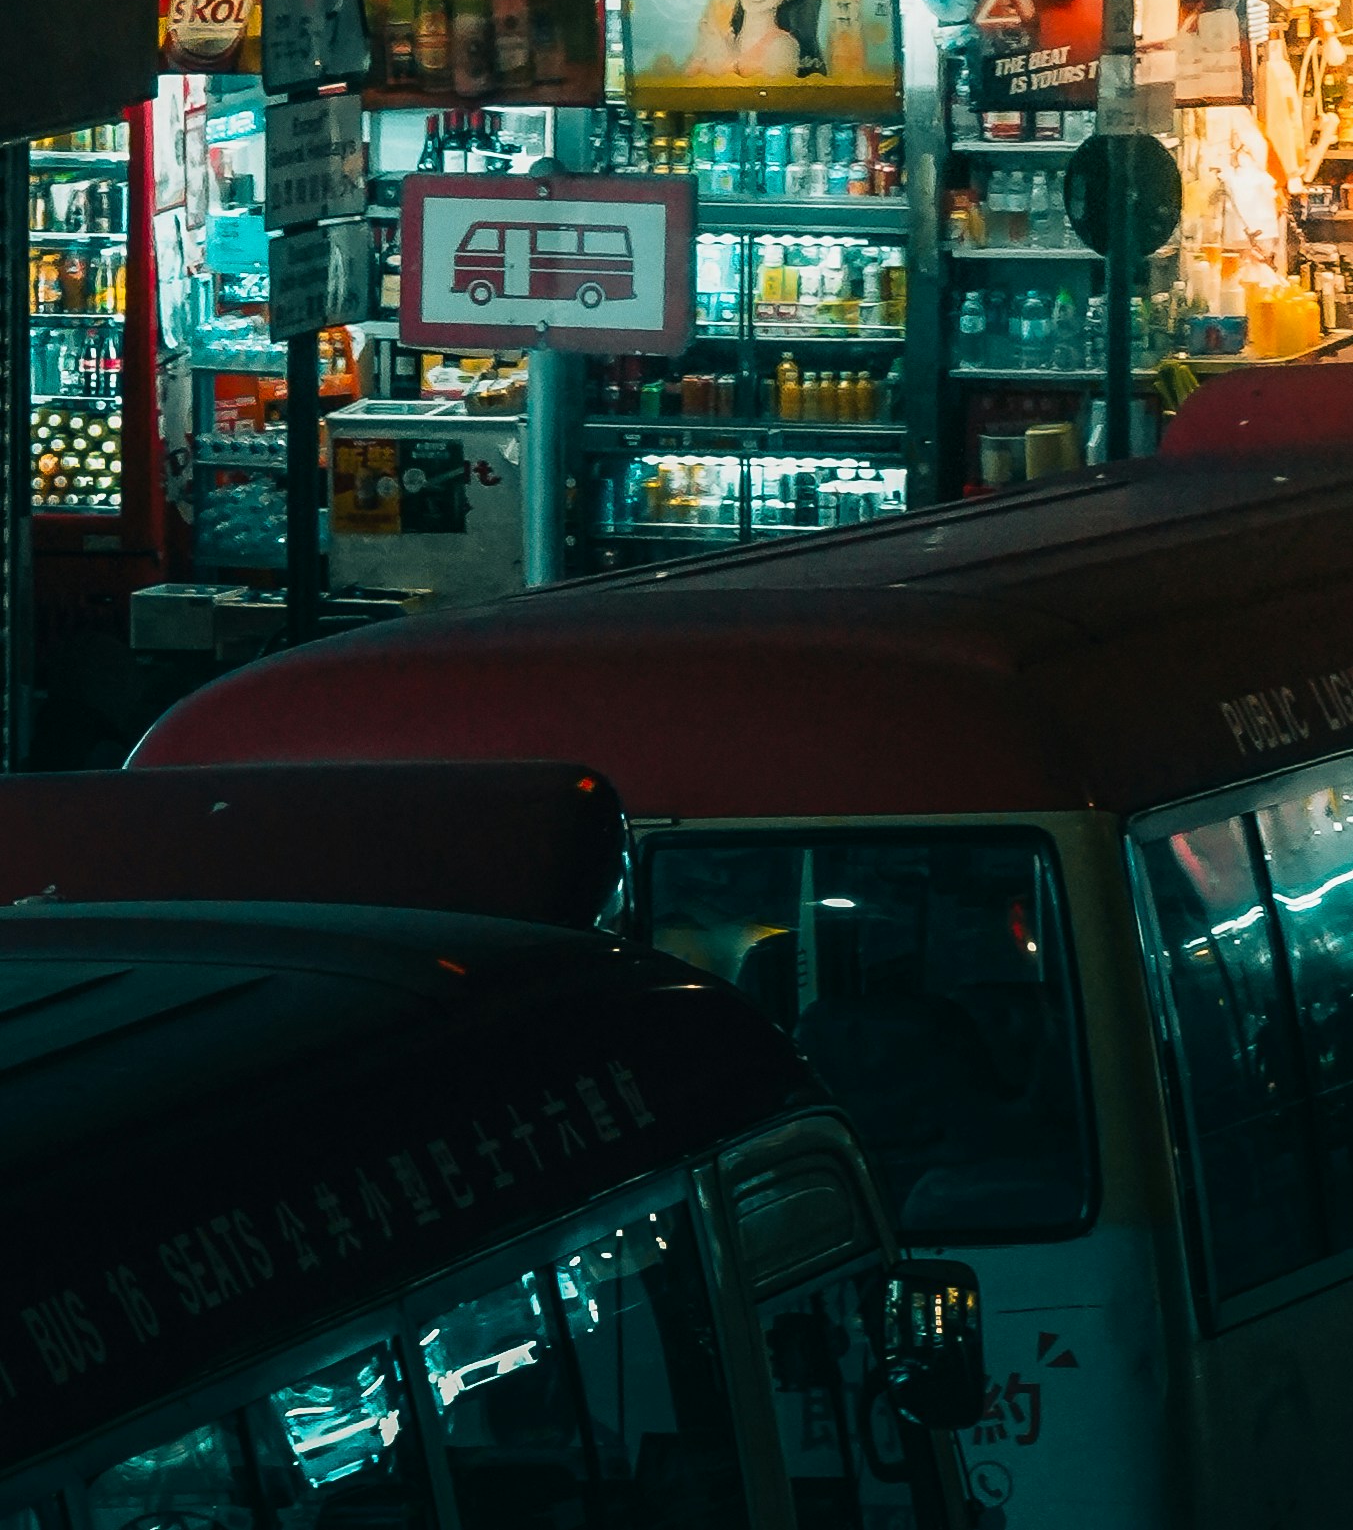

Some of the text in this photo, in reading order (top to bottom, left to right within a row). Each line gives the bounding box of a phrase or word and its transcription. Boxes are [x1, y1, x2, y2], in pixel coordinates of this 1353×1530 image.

[994, 46, 1071, 78] THE BEAT
[1218, 688, 1311, 756] PUBLIC
[19, 1296, 108, 1386] BUS
[155, 1208, 275, 1314] SEATS
